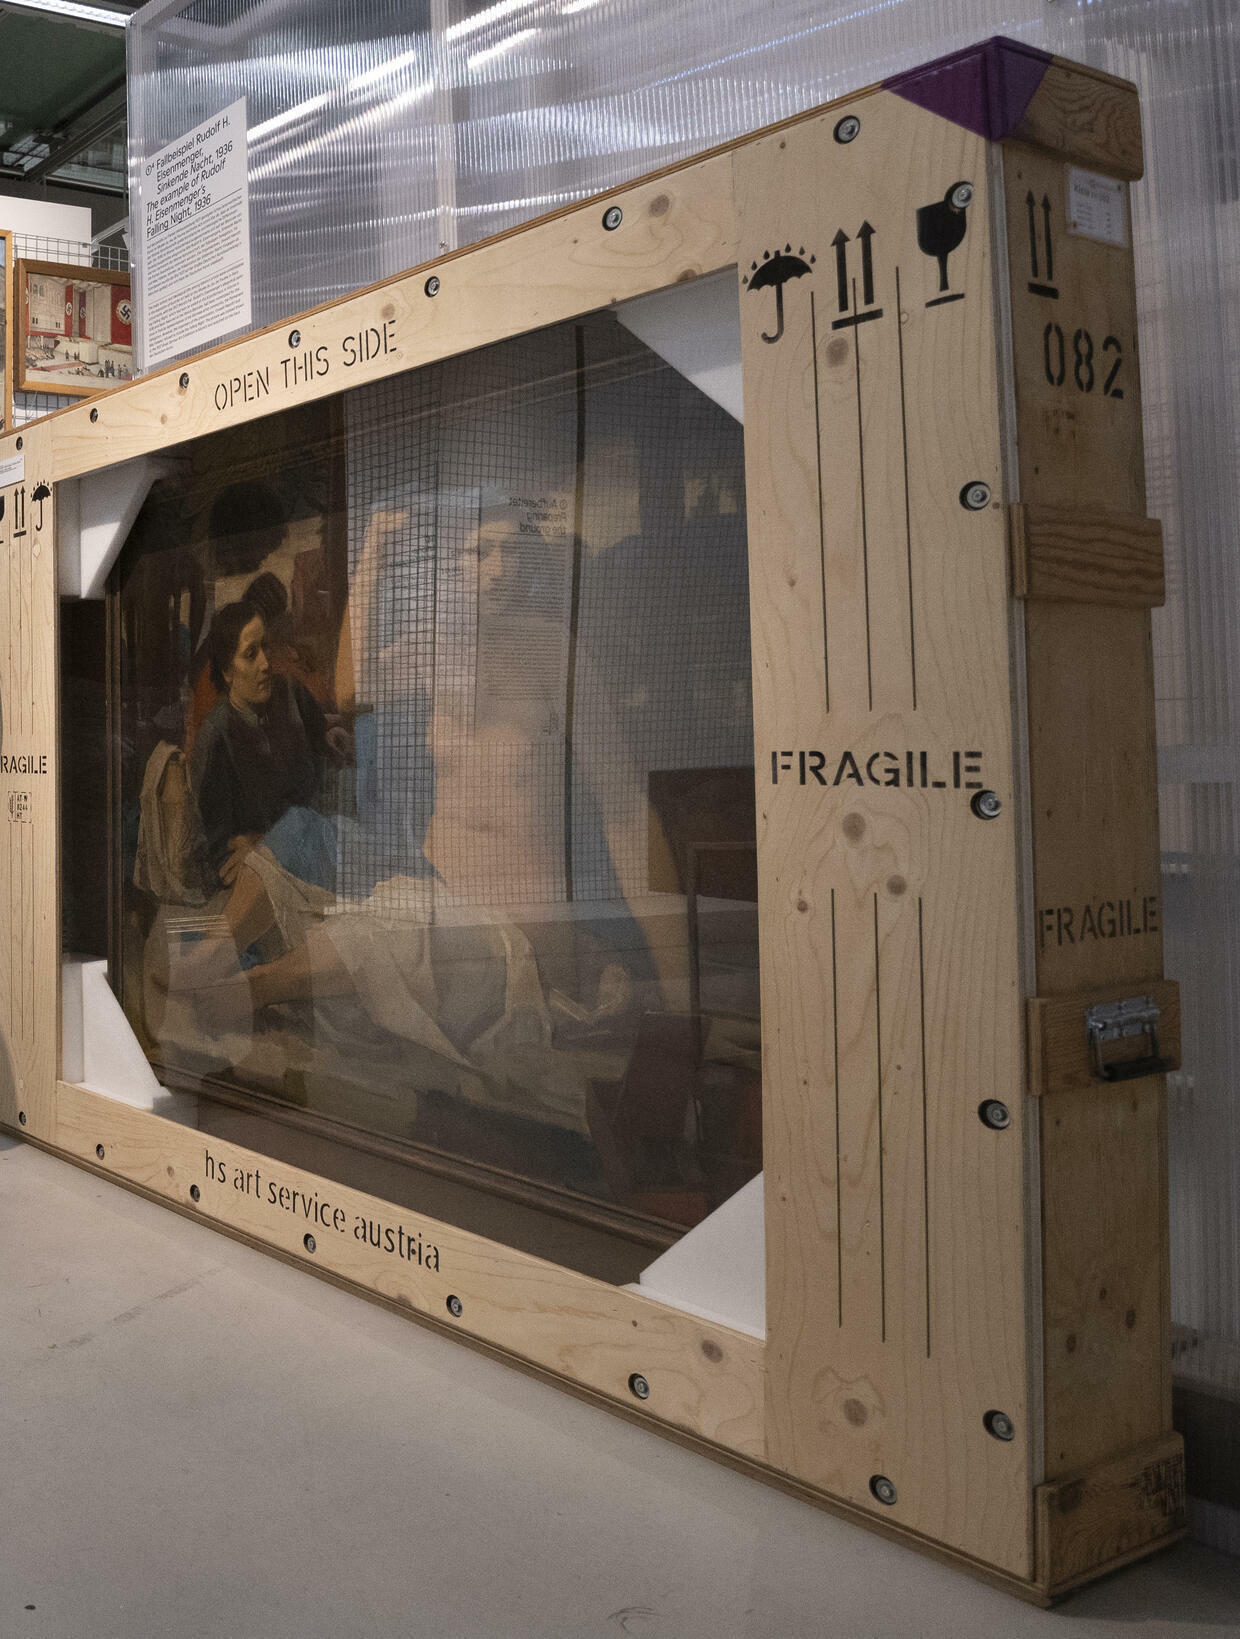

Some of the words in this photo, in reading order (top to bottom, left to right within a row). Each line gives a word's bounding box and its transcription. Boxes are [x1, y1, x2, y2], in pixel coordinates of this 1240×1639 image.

[156, 137, 195, 170] Fallbeispiel
[196, 120, 221, 145] Rudolf
[222, 115, 231, 129] H.
[156, 148, 204, 182] Eisenmenger,
[157, 169, 189, 195] Sinkende
[190, 154, 214, 175] Nacht,
[215, 140, 233, 159] 1936
[146, 200, 159, 213] The
[160, 182, 190, 206] example
[191, 173, 200, 187] of
[200, 157, 226, 182] Rudolf
[146, 220, 169, 239] Falling
[170, 207, 192, 225] Night,
[194, 193, 211, 211] 1936
[146, 214, 154, 226] H.
[214, 366, 270, 411] OPEN
[280, 346, 330, 388] THIS
[342, 319, 397, 367] SIDE
[1043, 322, 1124, 400] 082
[770, 750, 984, 789] FRAGILE
[1038, 896, 1159, 949] FRAGILE
[205, 1149, 227, 1184] hs
[233, 1168, 262, 1198] art
[267, 1181, 346, 1233] service
[353, 1216, 440, 1273] austria
